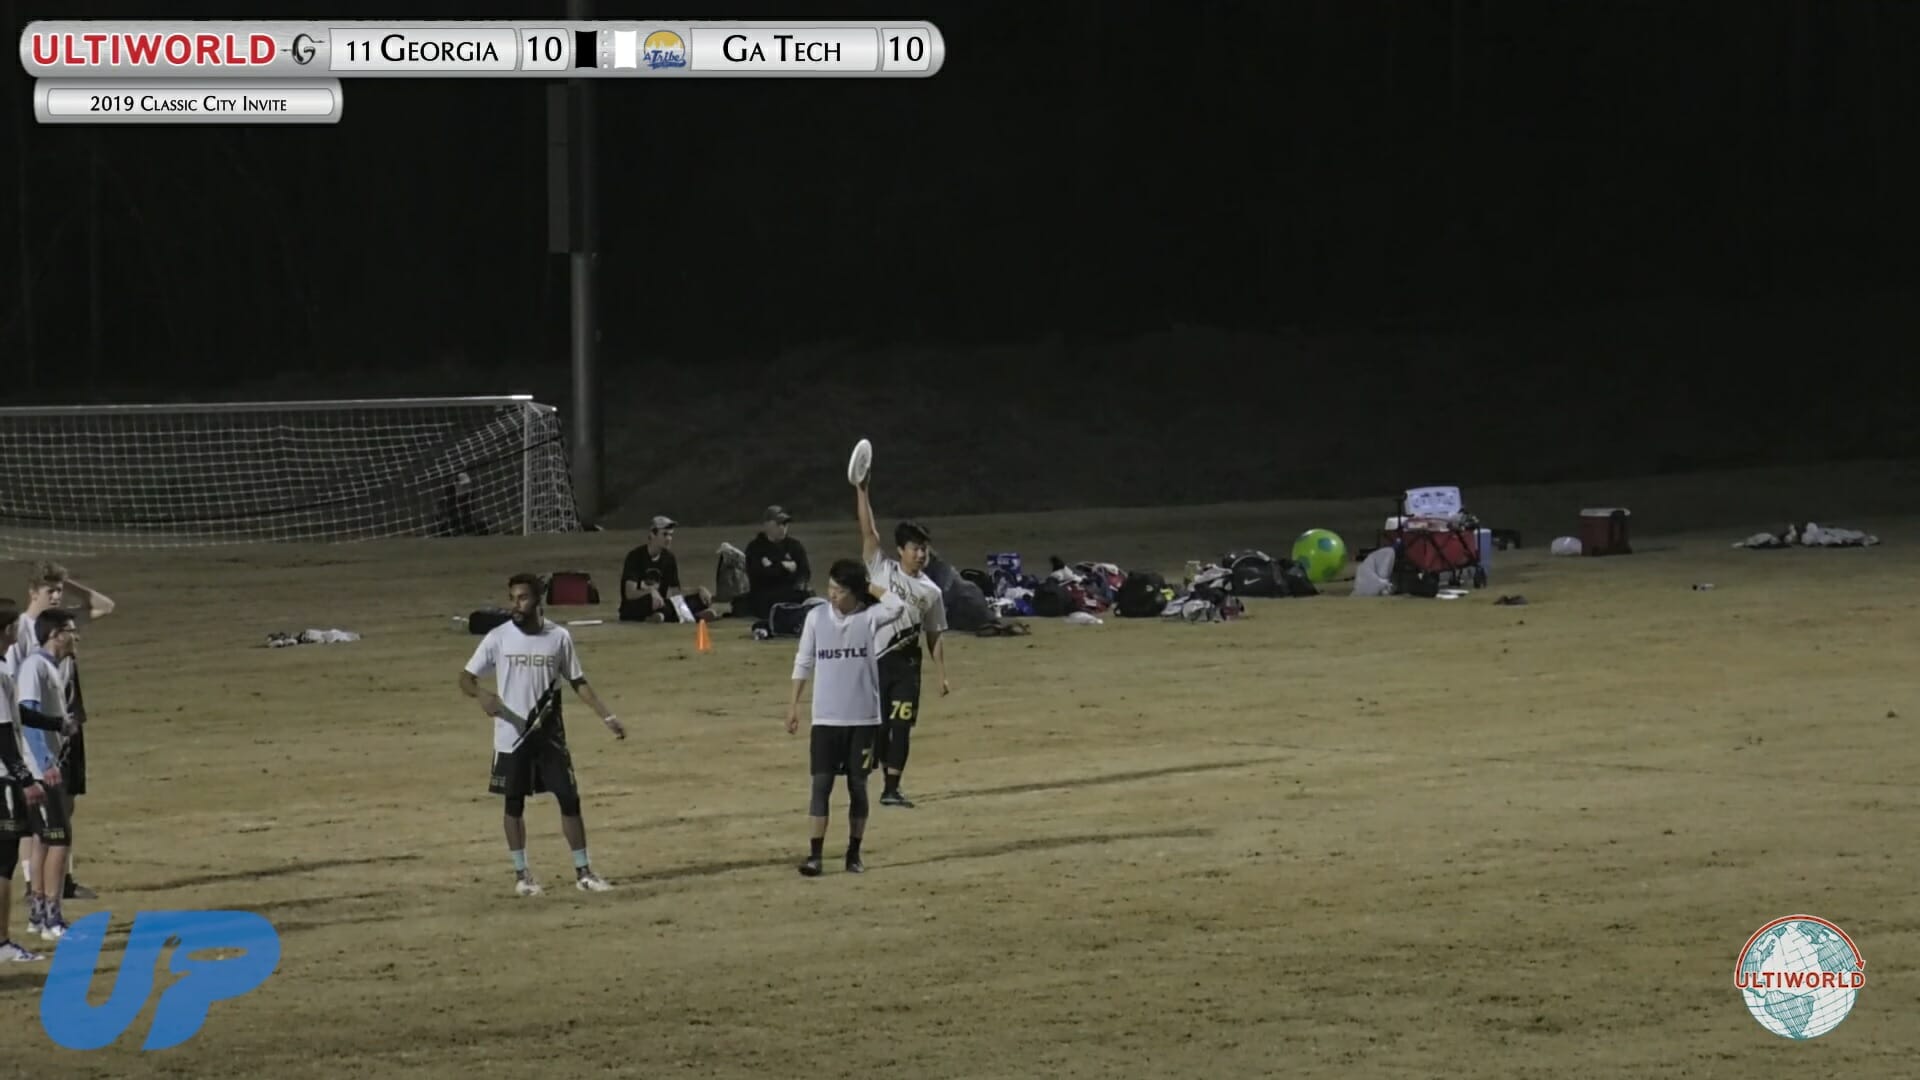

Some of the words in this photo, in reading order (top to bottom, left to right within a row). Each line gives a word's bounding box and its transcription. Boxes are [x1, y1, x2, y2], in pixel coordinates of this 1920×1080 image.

[818, 647, 868, 660] HUSTLE
[504, 654, 556, 667] TRIBE
[889, 700, 913, 720] 76
